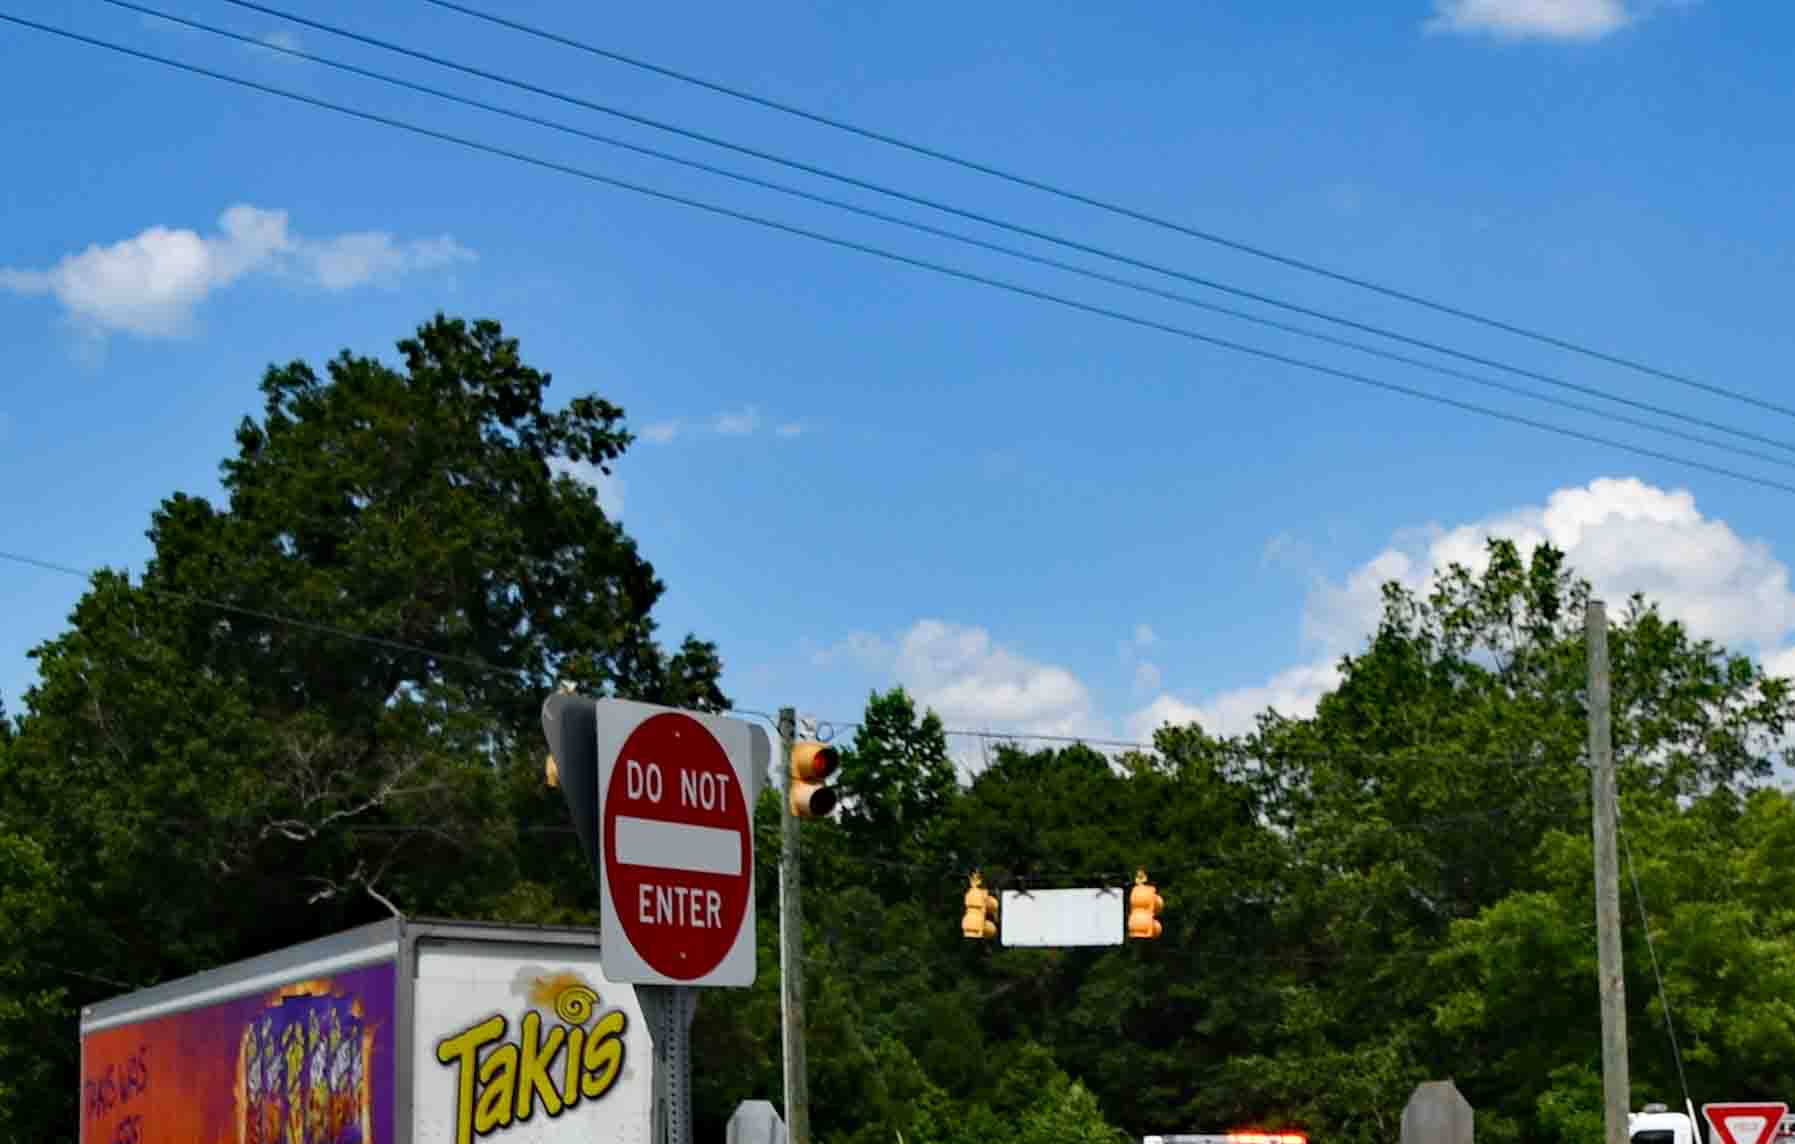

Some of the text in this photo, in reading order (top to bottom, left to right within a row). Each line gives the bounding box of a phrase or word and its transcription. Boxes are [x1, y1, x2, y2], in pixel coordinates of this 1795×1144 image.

[627, 760, 729, 813] DO NOT
[638, 883, 722, 928] ENTER
